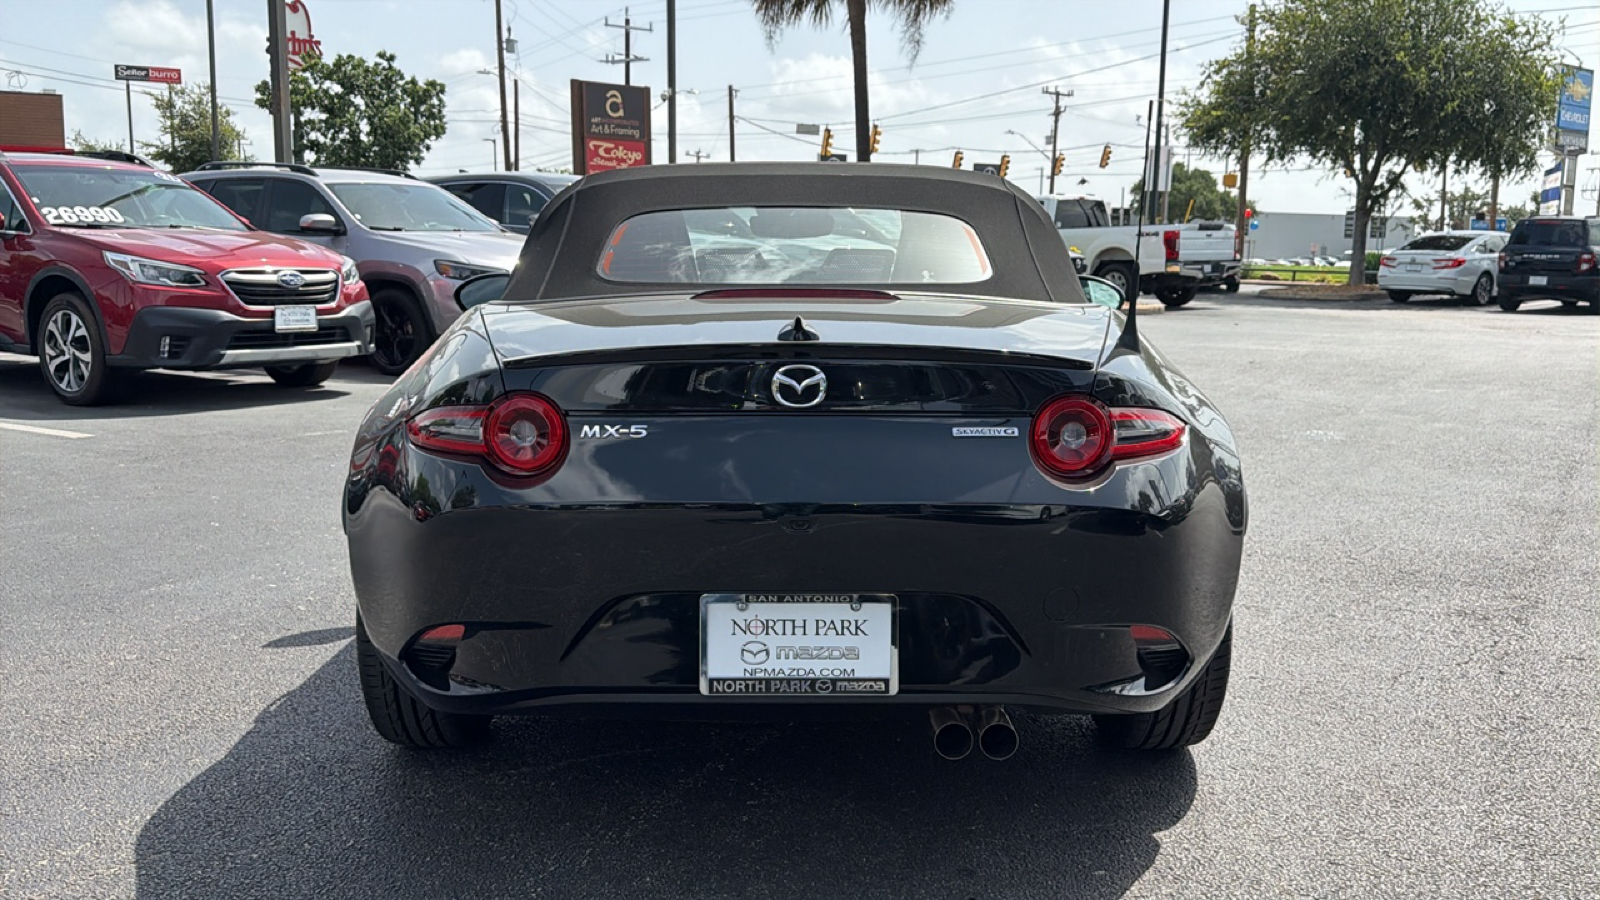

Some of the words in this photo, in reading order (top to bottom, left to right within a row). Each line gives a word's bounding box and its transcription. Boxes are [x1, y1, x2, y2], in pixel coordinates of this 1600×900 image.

[286, 30, 323, 56] rby's
[149, 68, 179, 80] burro
[590, 124, 603, 134] Art
[603, 124, 610, 134] &
[610, 125, 640, 139] Framing
[589, 140, 642, 164] Tokyo
[41, 205, 125, 224] 26990
[579, 424, 649, 439] MX-5
[954, 428, 1002, 436] SKYACTIV
[748, 595, 780, 603] SAN
[783, 595, 851, 603] ANTONIO
[731, 618, 807, 637] NORTH
[814, 618, 869, 637] PARK
[775, 645, 860, 661] mazda
[743, 668, 856, 678] NPMAZDA.COM
[713, 680, 766, 693] NORTH
[770, 680, 812, 693] PARK
[836, 680, 886, 692] mazda
